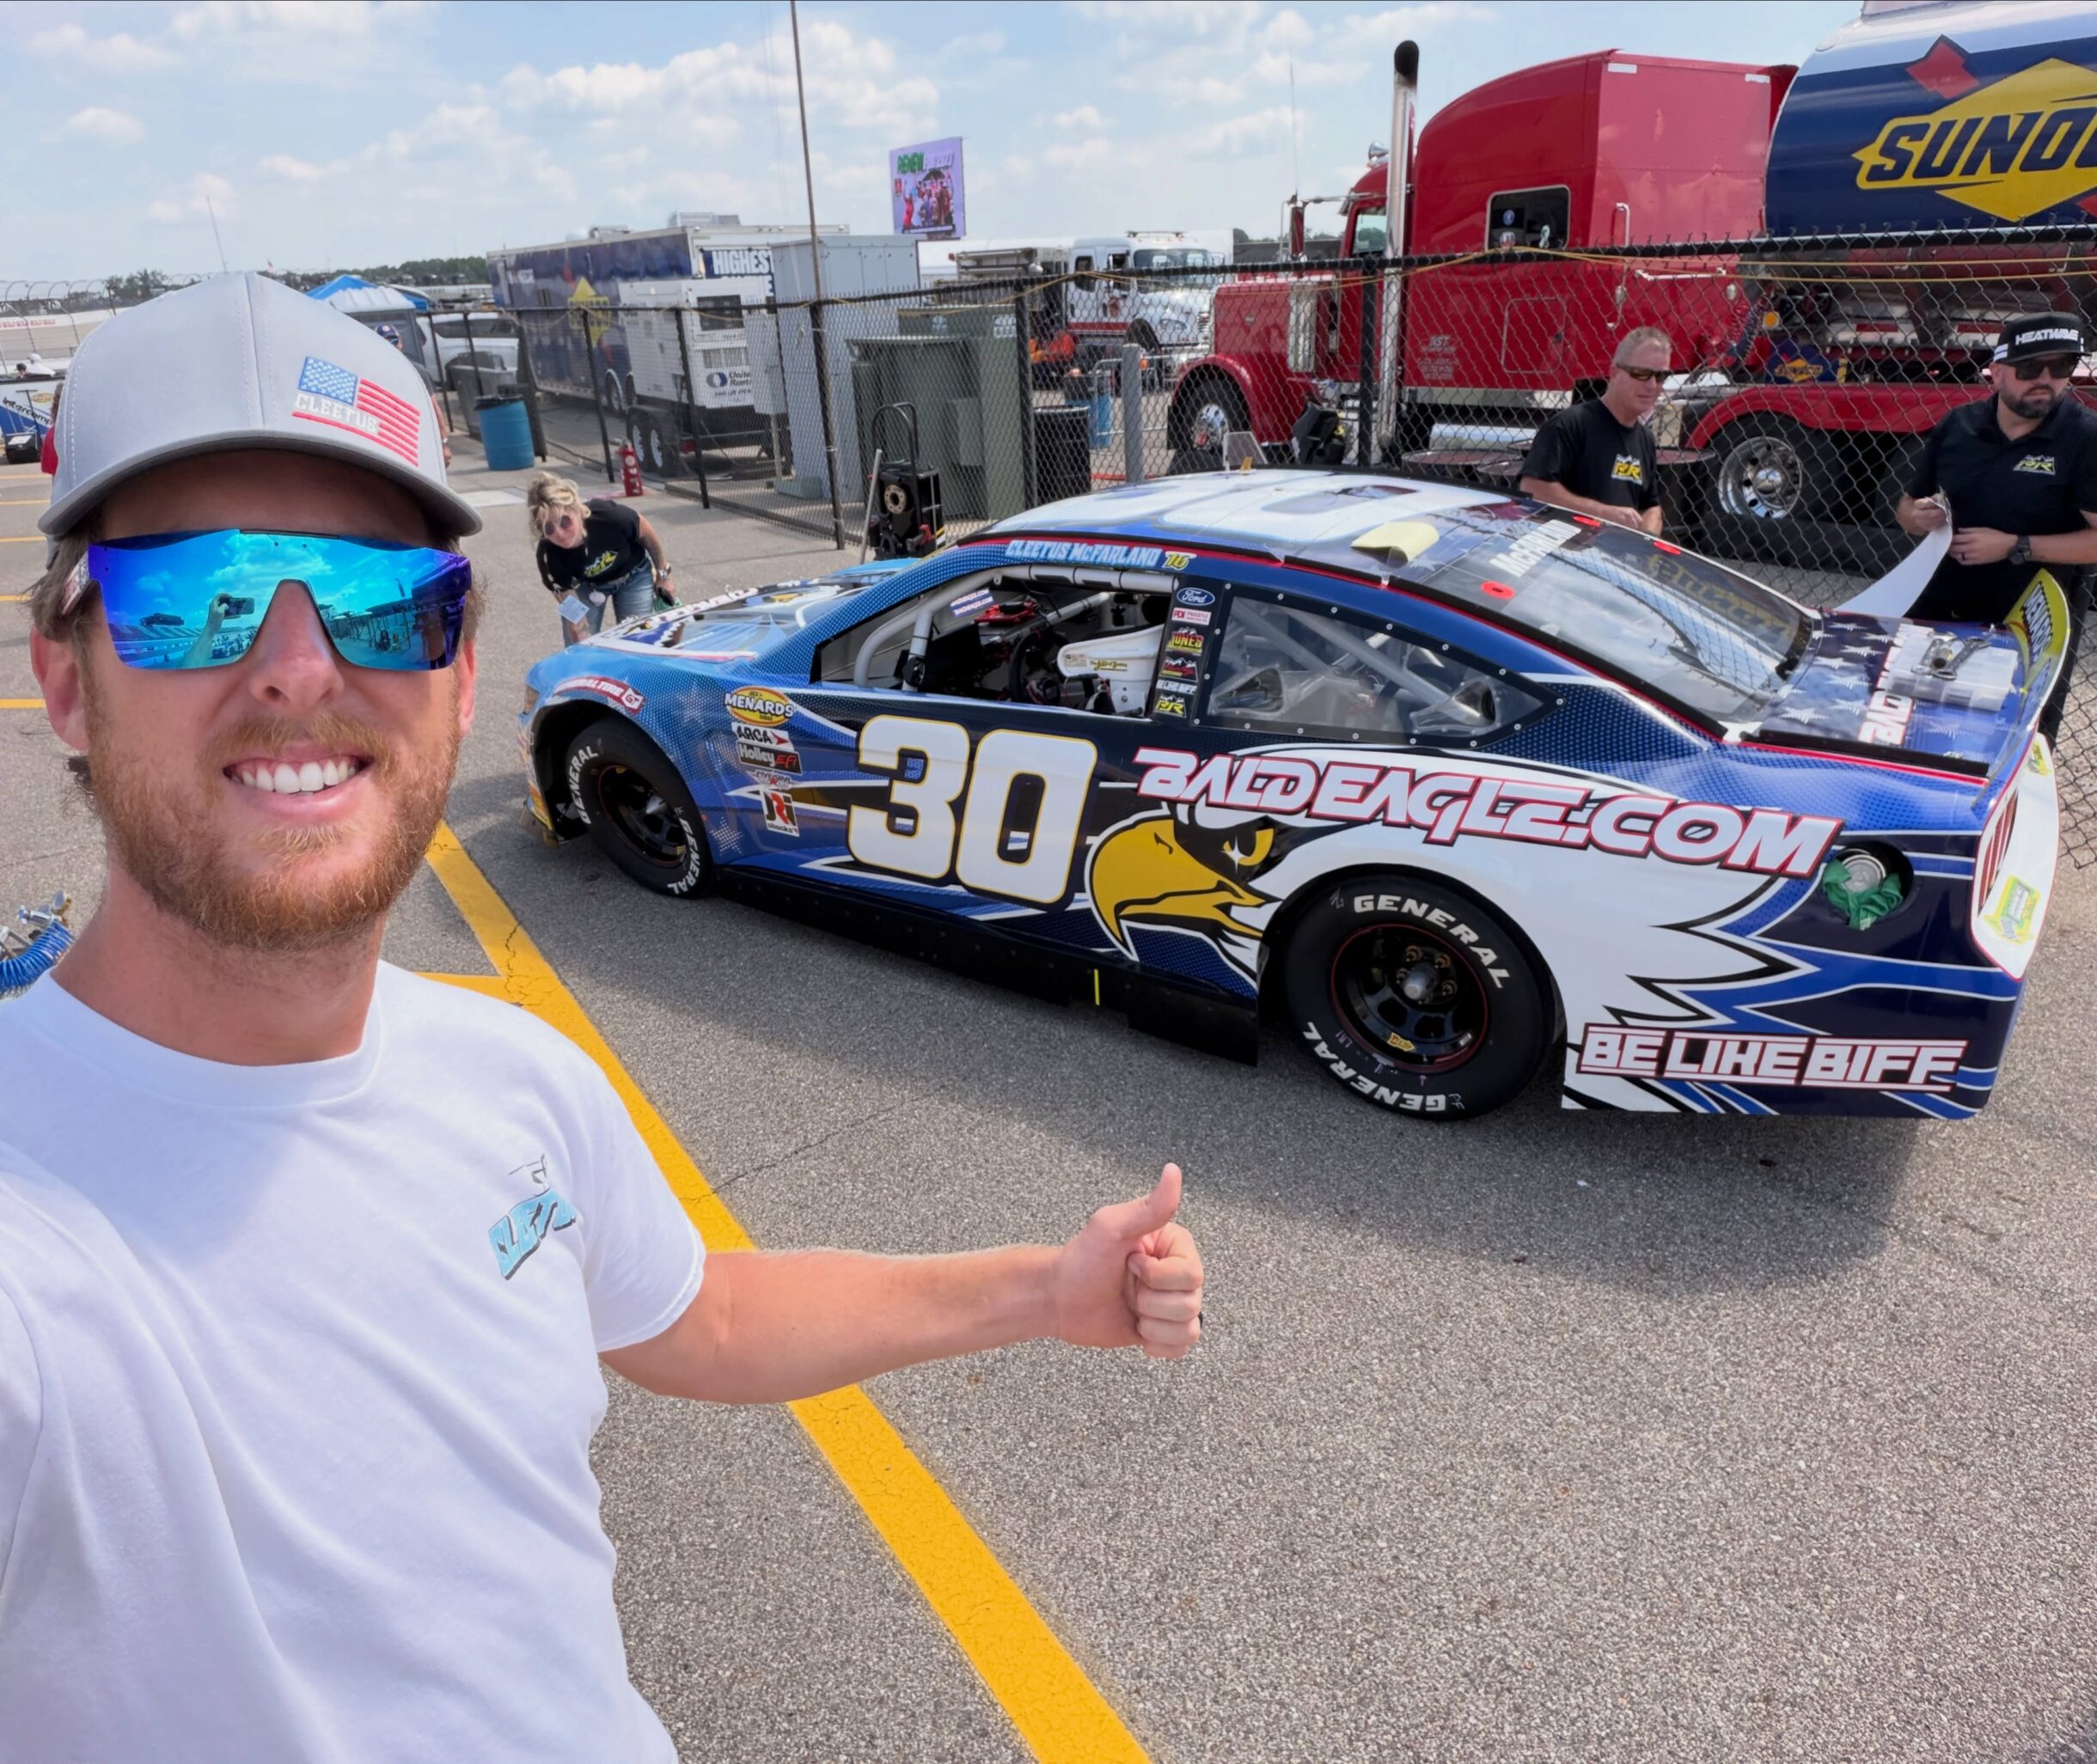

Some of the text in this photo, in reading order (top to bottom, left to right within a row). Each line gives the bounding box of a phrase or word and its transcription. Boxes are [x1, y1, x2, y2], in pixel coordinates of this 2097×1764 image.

[294, 393, 379, 435] CLEETUS
[1005, 539, 1071, 561] CLEETUS
[1070, 542, 1163, 568] McFARLAND
[1182, 589, 1208, 604] Ford
[724, 693, 795, 717] MENARDS
[737, 725, 773, 744] ARCA
[569, 746, 599, 825] GENERAL
[739, 743, 776, 767] Holley
[847, 714, 1097, 904] 30
[1133, 746, 1845, 879] BALDEAGLE.COM
[667, 817, 700, 894] GENERAL
[1354, 894, 1510, 989] GENERAL
[1302, 1022, 1446, 1112] GENERAL
[1580, 1028, 1969, 1091] BE LIKE BIFF
